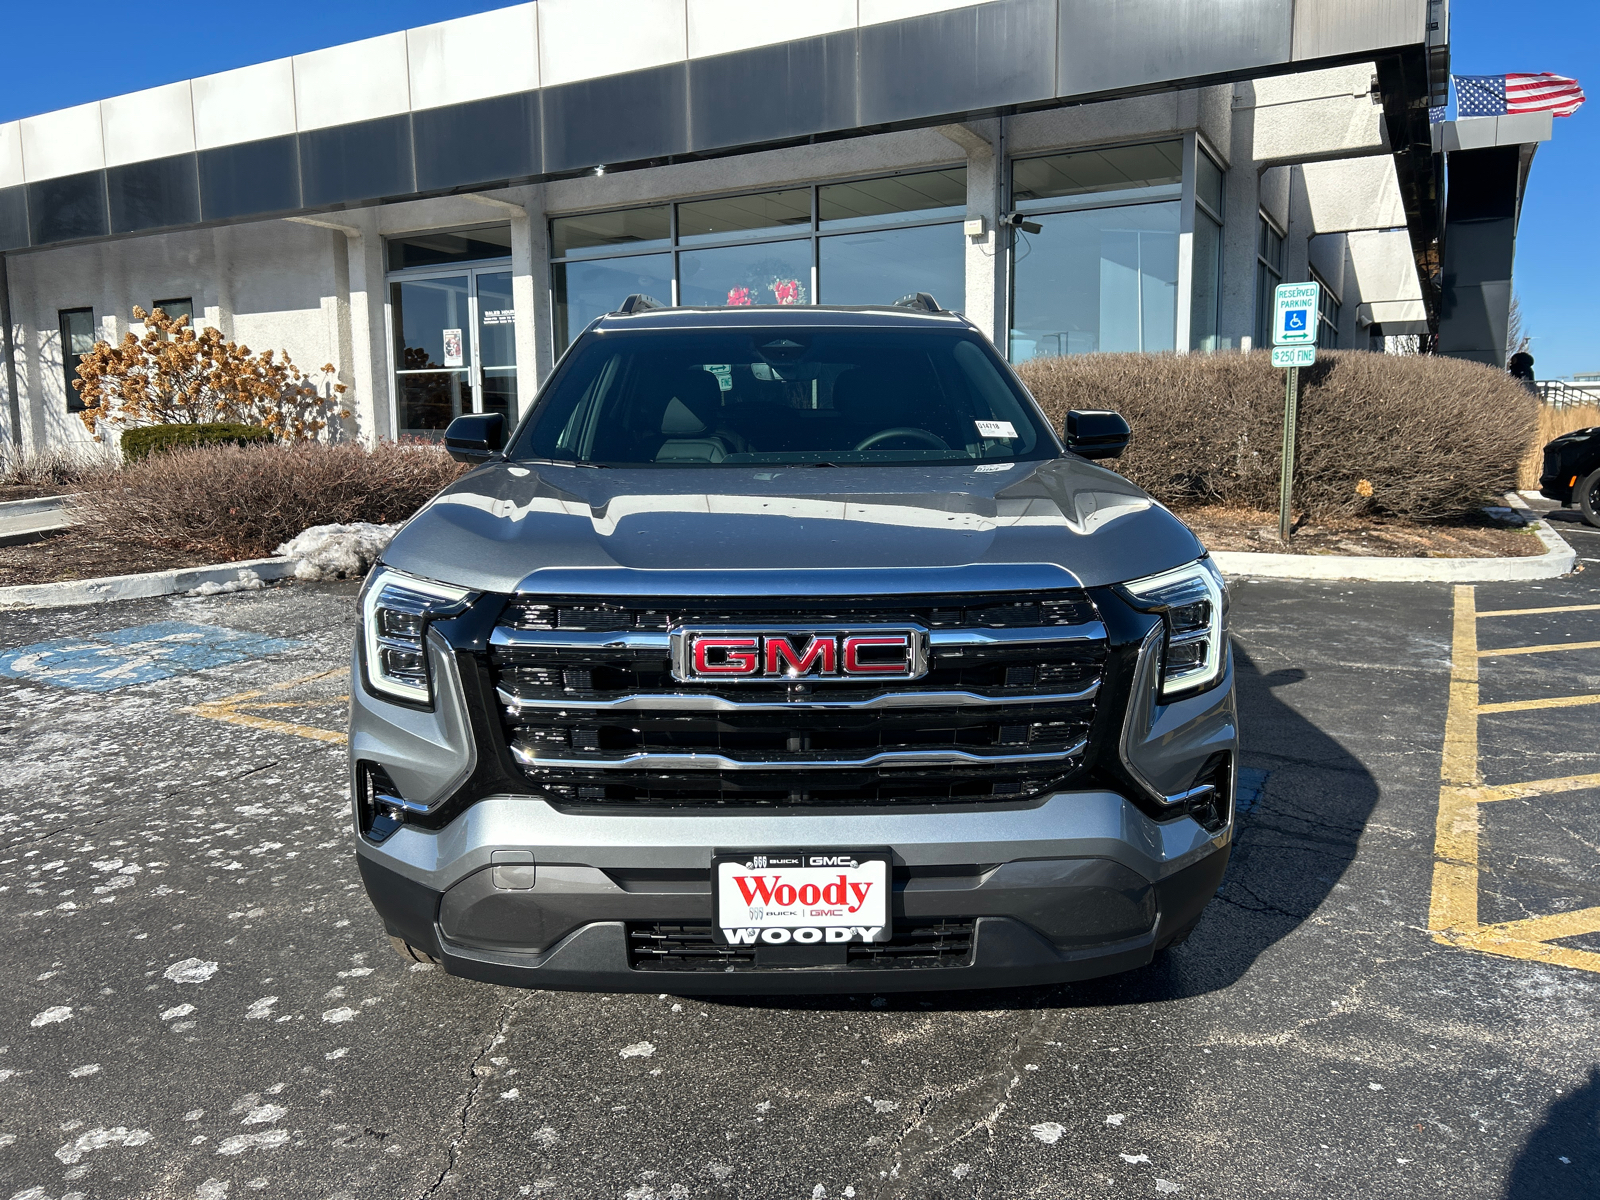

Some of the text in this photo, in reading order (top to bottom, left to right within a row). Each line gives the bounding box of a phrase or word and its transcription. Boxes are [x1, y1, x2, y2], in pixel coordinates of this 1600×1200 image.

[1279, 288, 1315, 298] RESERVED
[1281, 299, 1312, 308] PARKING
[1274, 350, 1313, 362] $250 FINE
[692, 635, 910, 676] GMC
[809, 856, 851, 866] GMC
[732, 875, 873, 913] Woody
[810, 909, 843, 917] GMC
[722, 927, 882, 945] WOODY
